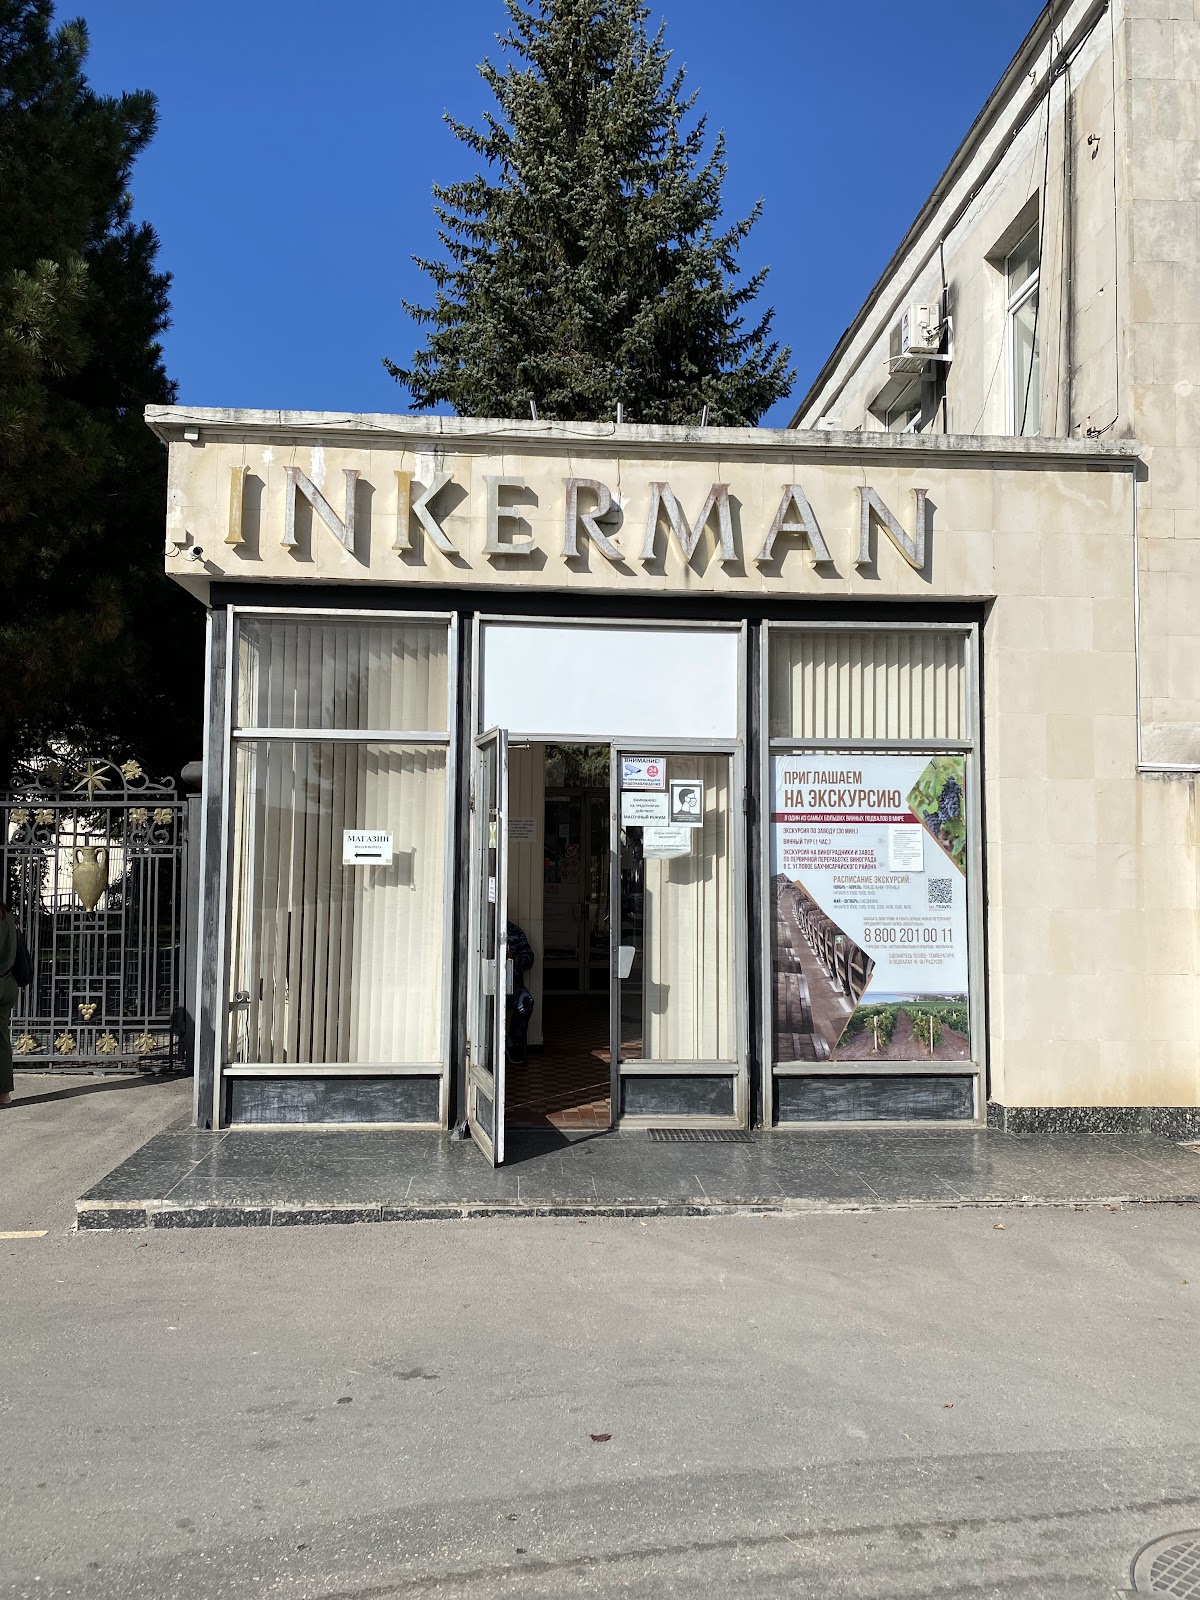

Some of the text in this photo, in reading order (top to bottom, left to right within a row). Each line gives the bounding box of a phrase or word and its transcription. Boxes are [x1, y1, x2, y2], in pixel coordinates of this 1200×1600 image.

[224, 464, 929, 569] INKERMAN
[784, 771, 862, 785] ПРИГЛАШАЕМ
[784, 789, 902, 808] НА ЭКСКУРСИЮ
[874, 875, 911, 883] ЭКСКУРСИЙ:
[864, 928, 952, 942] 8 800 201 00 11
